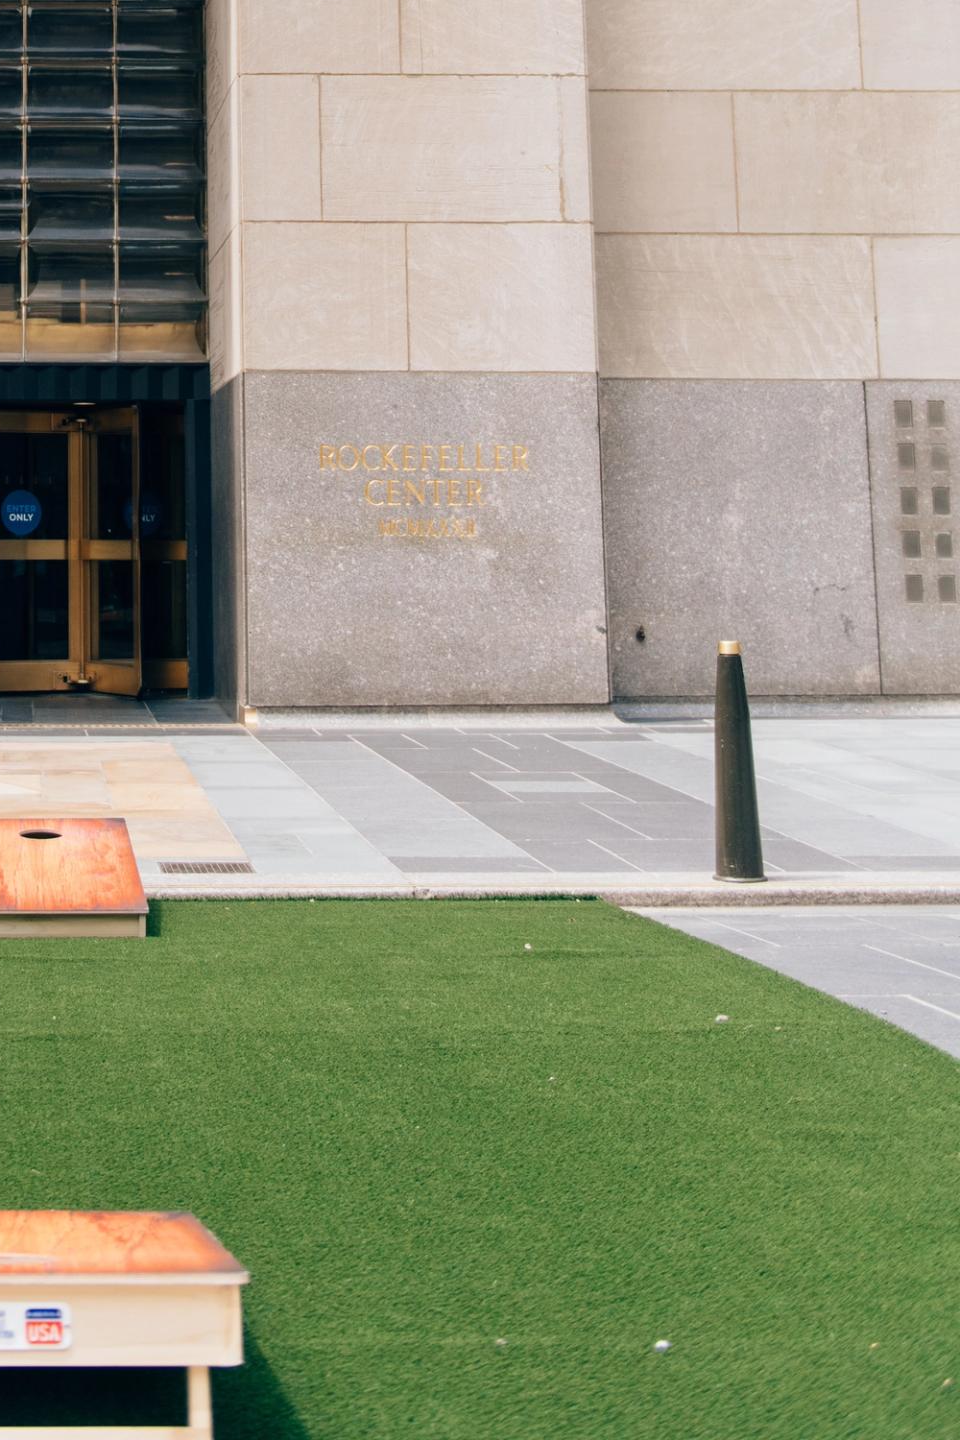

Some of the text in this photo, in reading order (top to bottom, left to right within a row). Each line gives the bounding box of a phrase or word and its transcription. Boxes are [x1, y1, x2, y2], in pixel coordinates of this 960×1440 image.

[319, 444, 530, 471] ROCKEFELLER
[364, 479, 487, 506] CENTER
[9, 513, 34, 522] ONLY
[27, 1322, 61, 1342] USA
